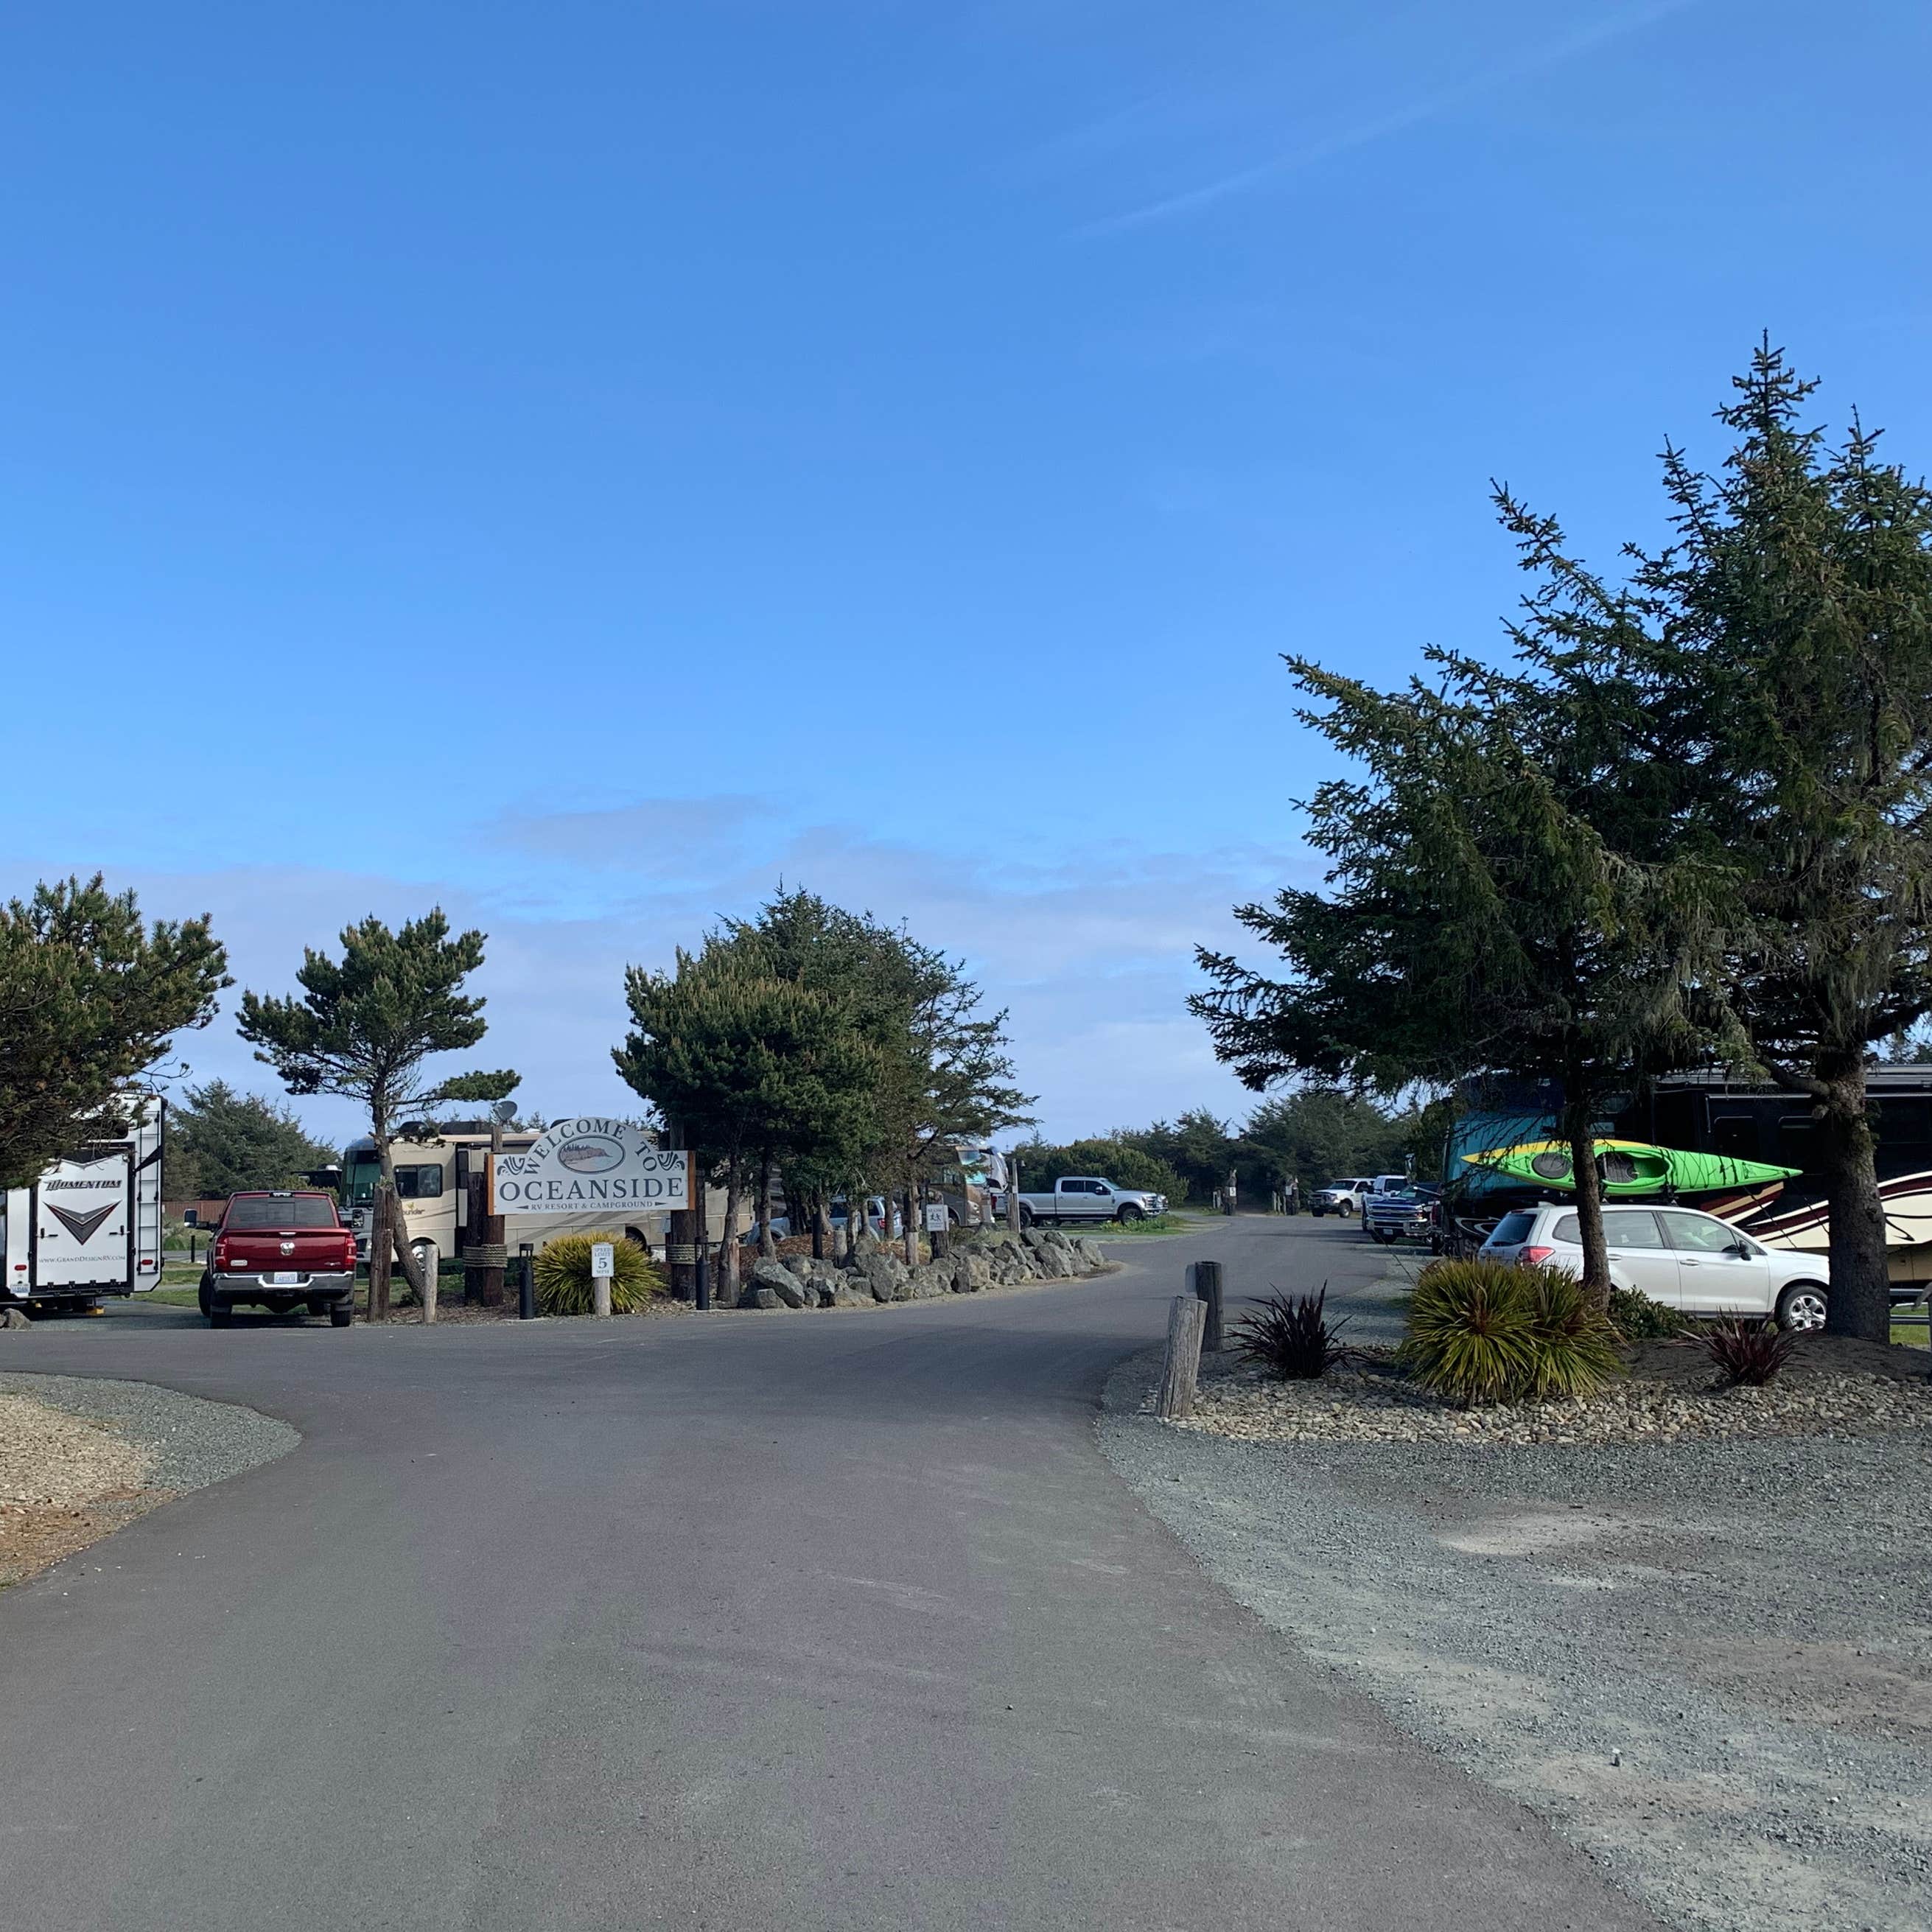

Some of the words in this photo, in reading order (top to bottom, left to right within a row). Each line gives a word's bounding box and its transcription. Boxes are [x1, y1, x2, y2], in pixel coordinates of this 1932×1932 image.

[523, 1119, 626, 1175] WELCOME
[634, 1141, 657, 1172] TO
[43, 1180, 122, 1191] MOMENTUM
[499, 1177, 684, 1202] OCEANSIDE
[590, 1200, 653, 1208] CAMPGROUND
[598, 1257, 608, 1268] 5
